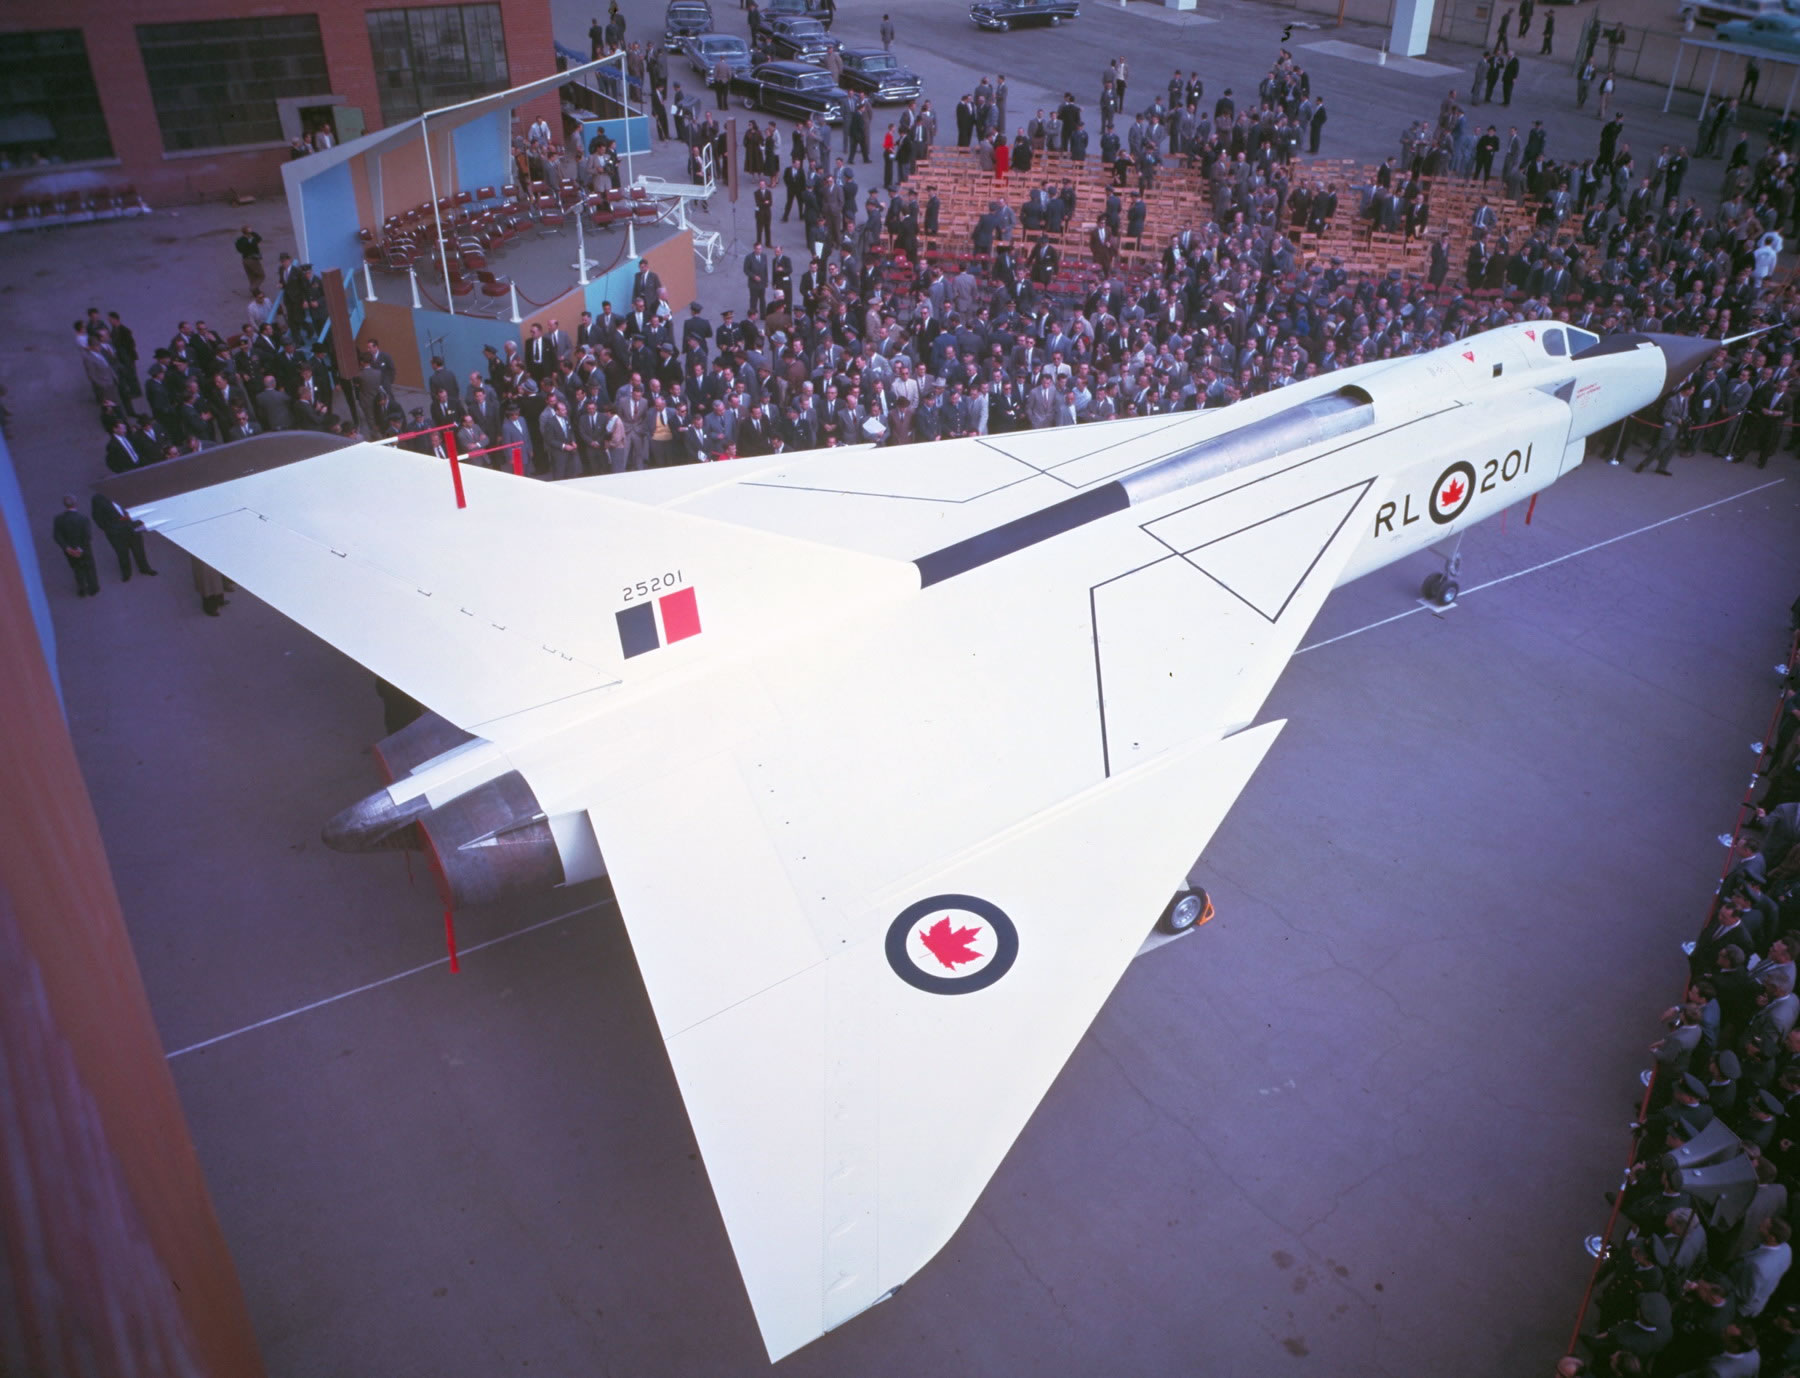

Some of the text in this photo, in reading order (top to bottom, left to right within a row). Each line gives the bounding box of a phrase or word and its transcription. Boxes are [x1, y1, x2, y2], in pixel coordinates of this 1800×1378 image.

[1374, 442, 1533, 538] RL 201
[622, 569, 682, 601] 25201
